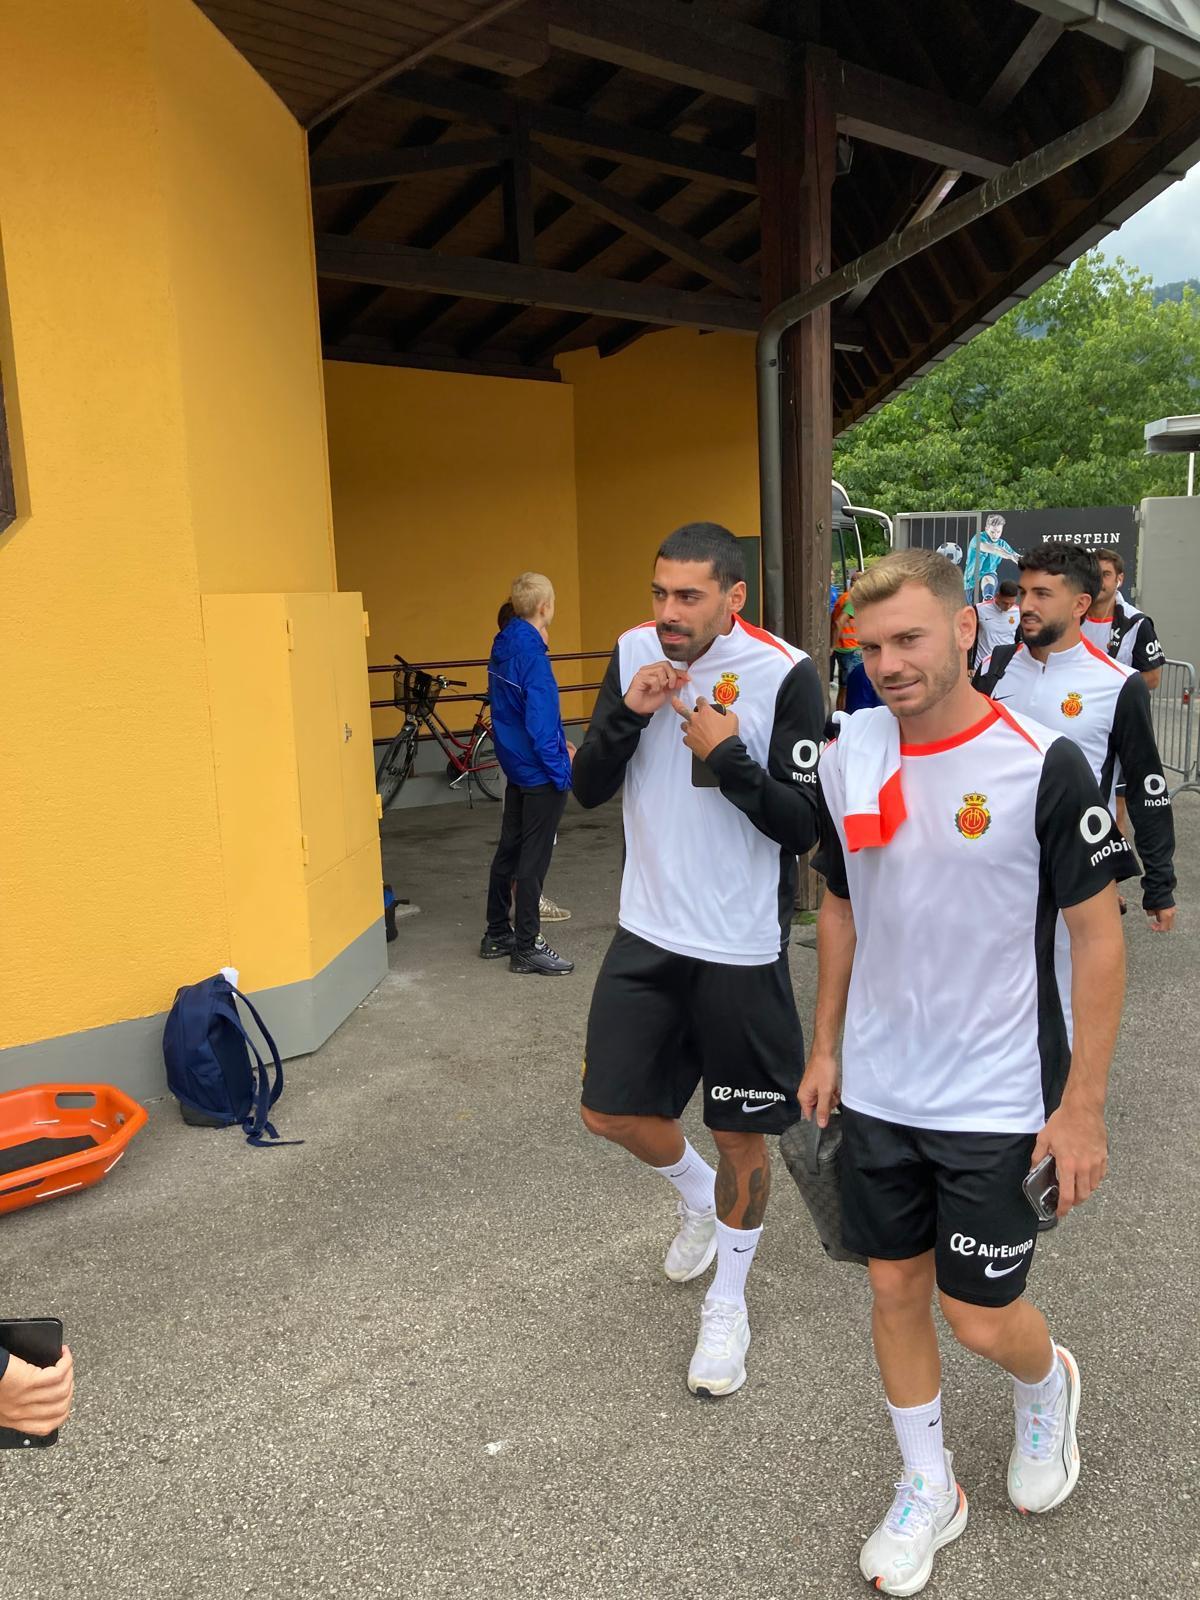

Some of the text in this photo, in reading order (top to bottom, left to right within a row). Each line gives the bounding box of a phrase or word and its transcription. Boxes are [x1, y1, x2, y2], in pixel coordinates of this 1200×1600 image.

[1079, 805, 1112, 844] O
[733, 1088, 787, 1102] AirEuropa
[977, 1238, 1034, 1258] AirEuropa
